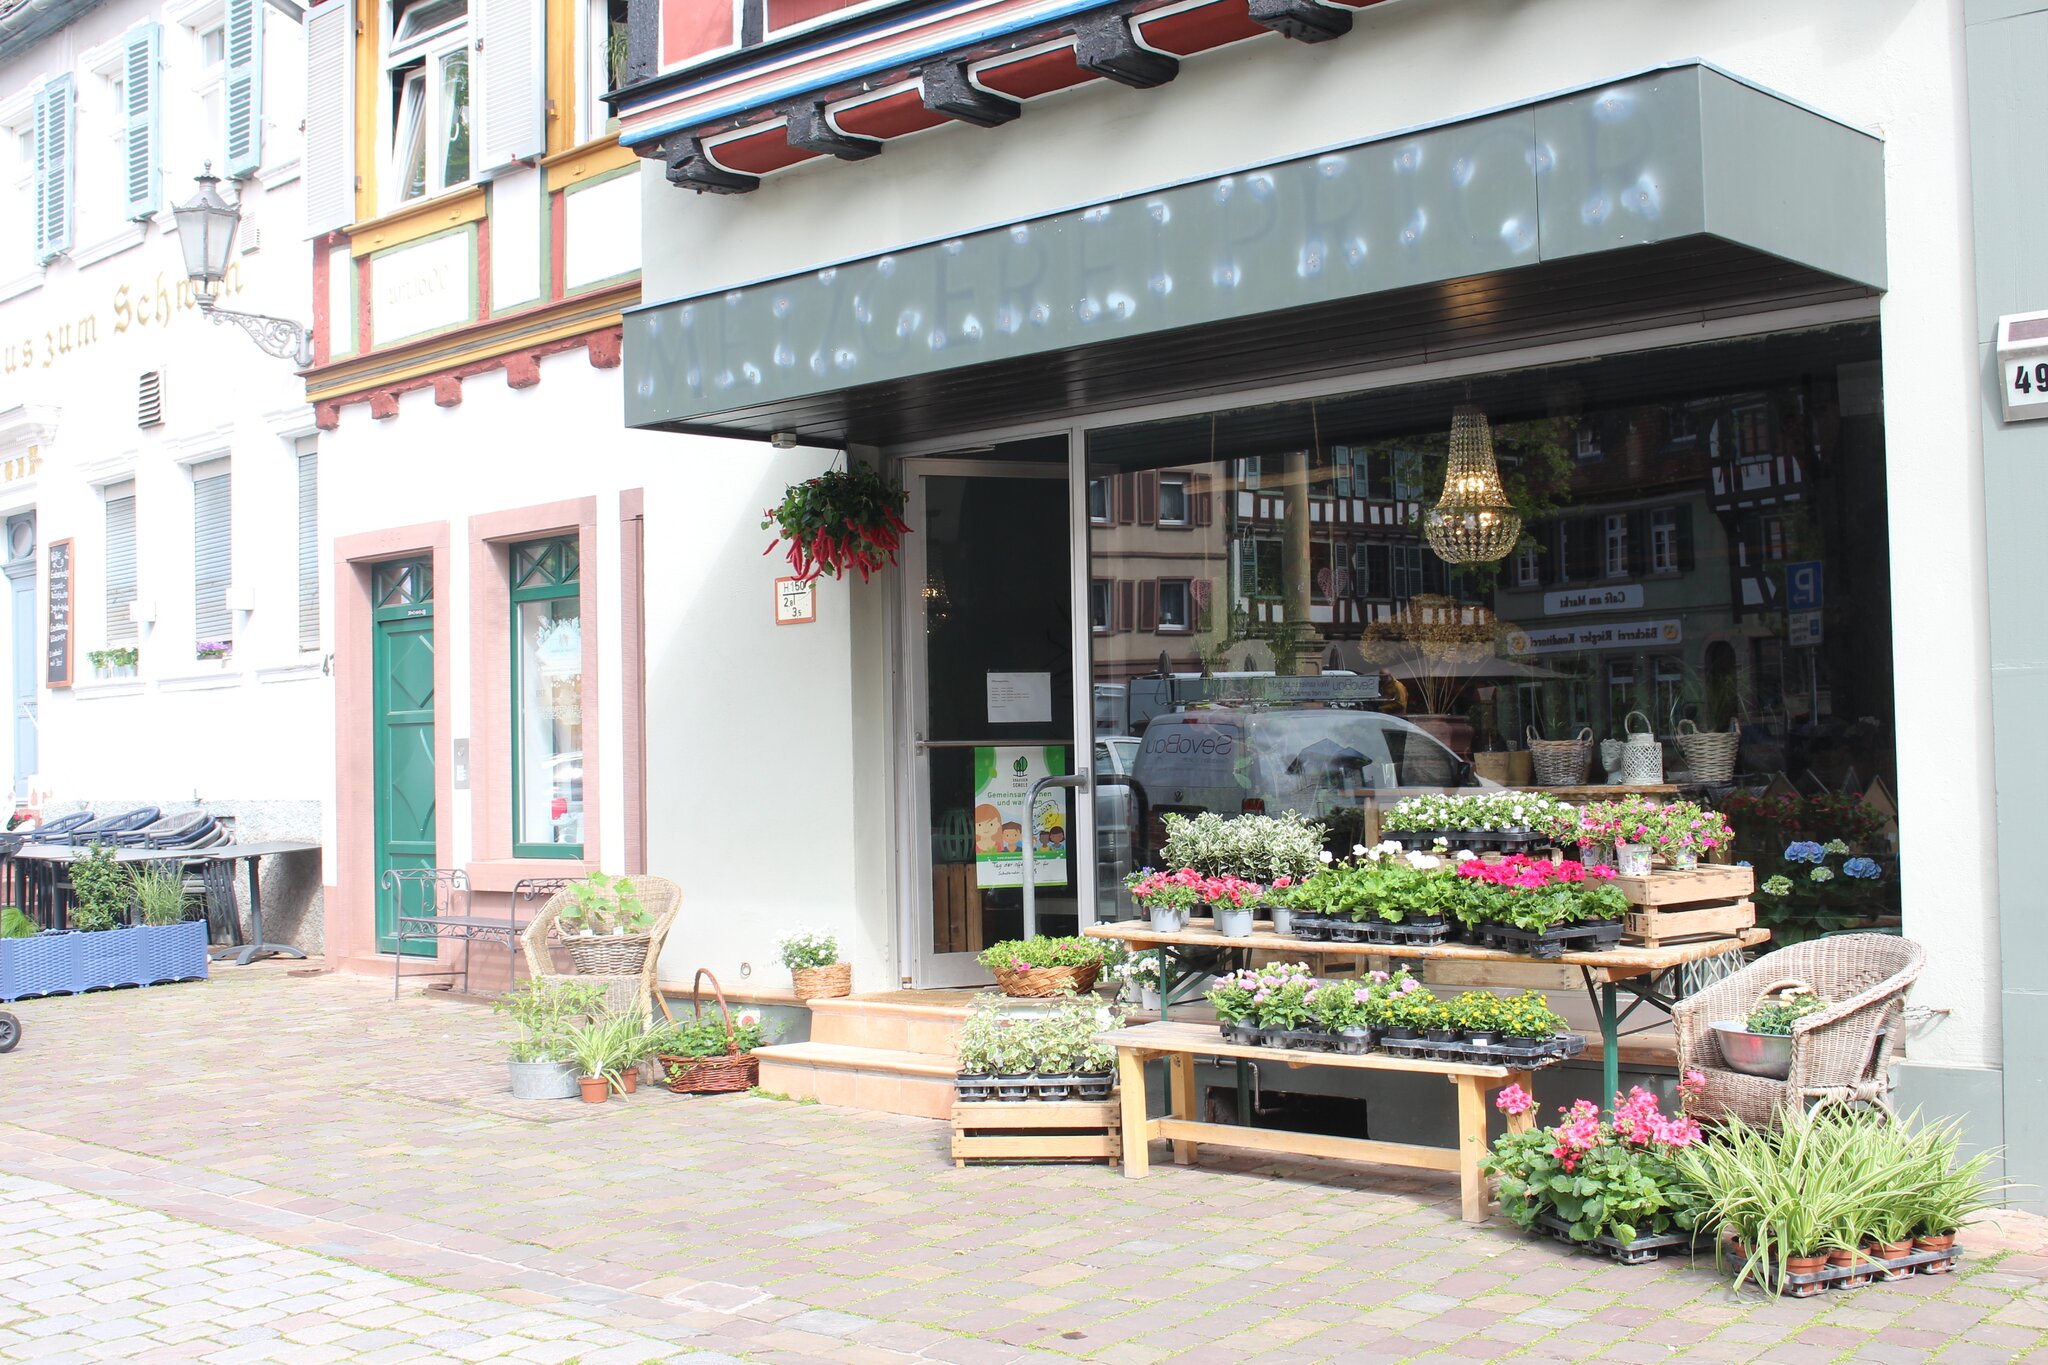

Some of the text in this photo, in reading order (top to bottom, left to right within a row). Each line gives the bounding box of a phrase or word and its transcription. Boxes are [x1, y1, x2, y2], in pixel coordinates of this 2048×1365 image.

[43, 313, 98, 369] zum
[2014, 362, 2048, 395] 49
[997, 799, 1011, 807] und
